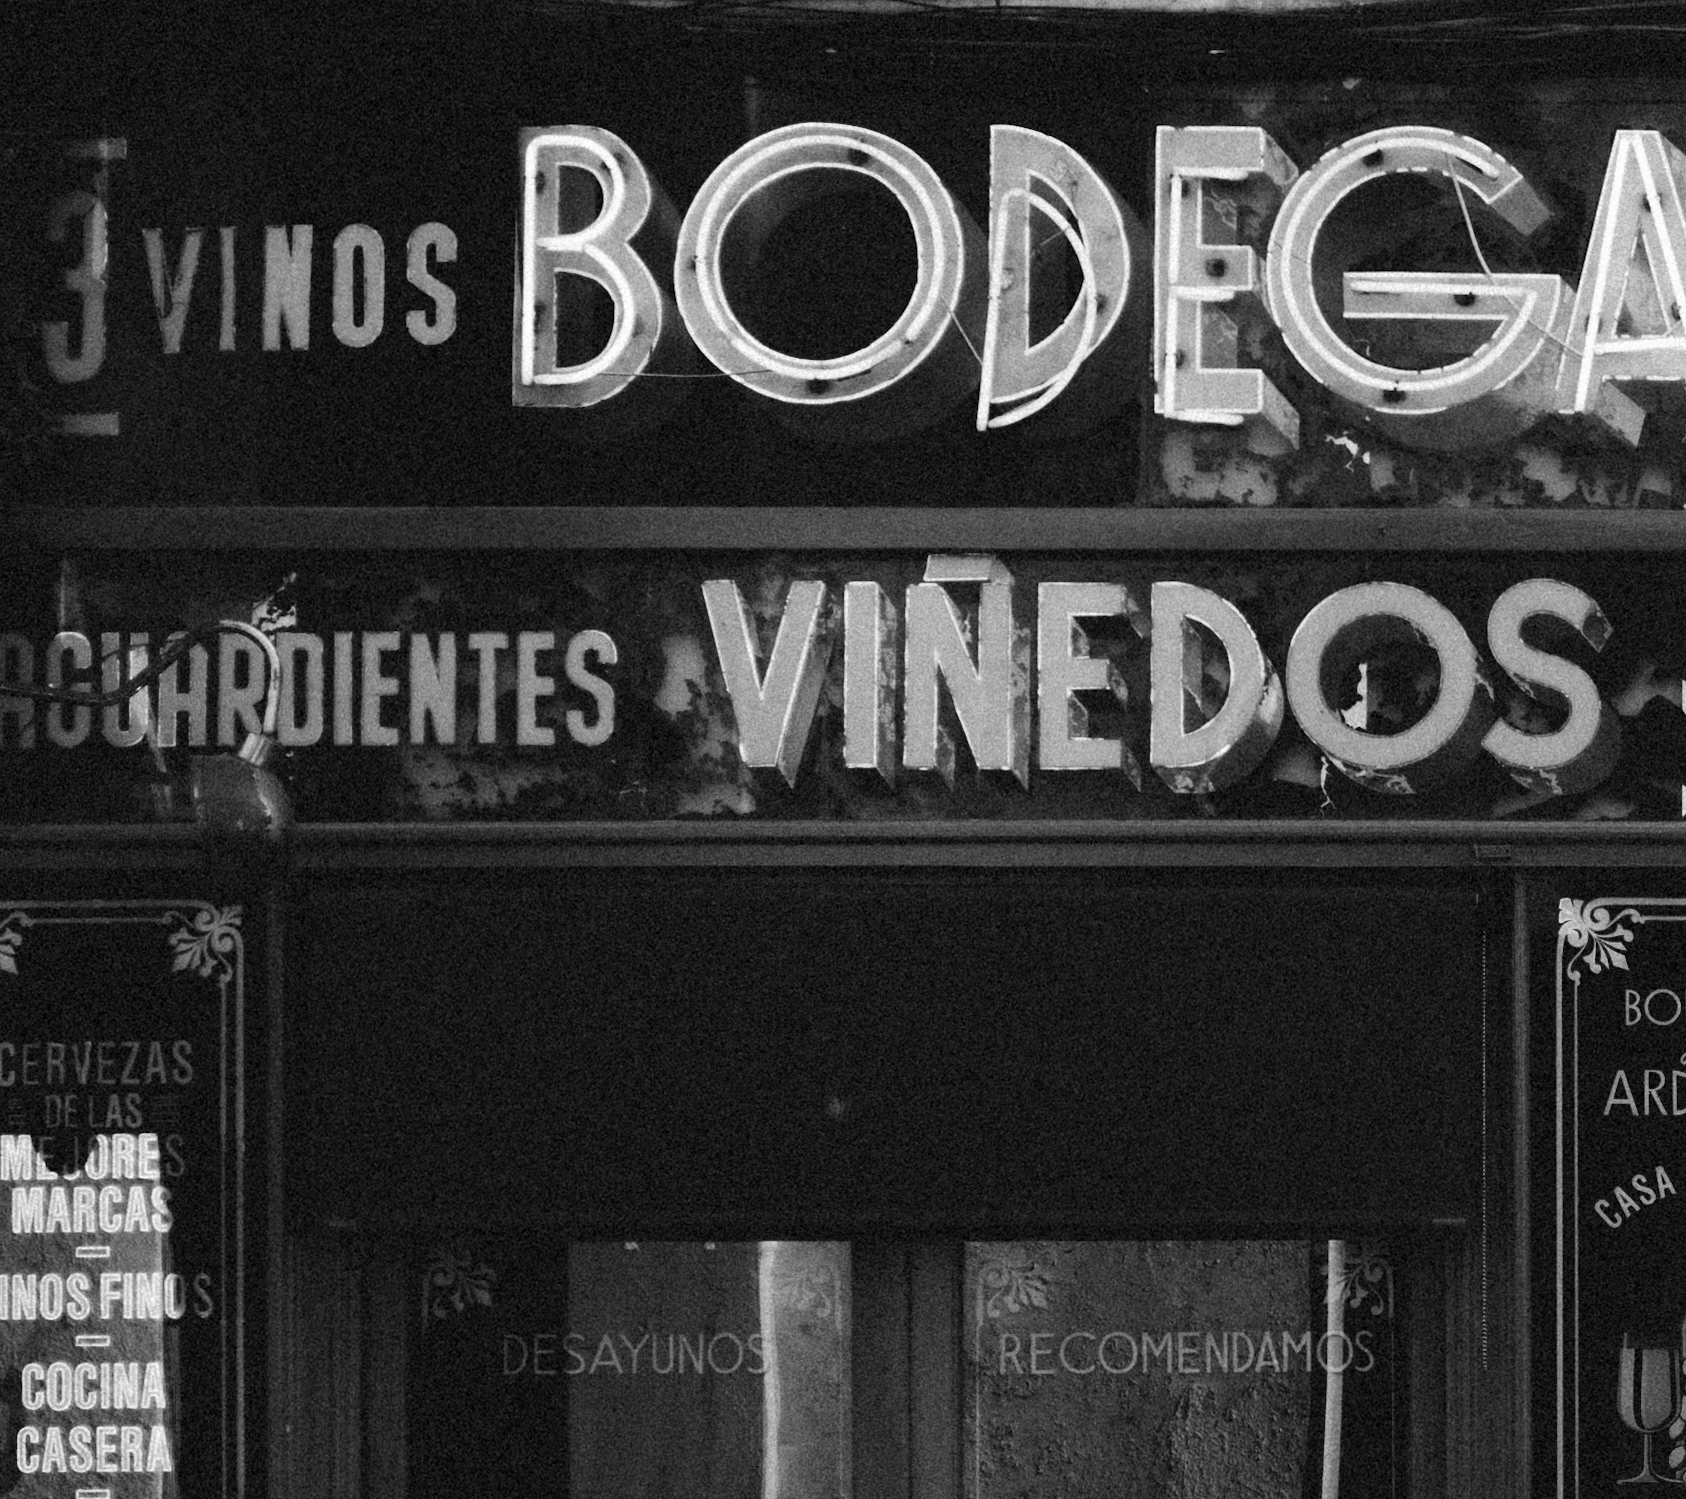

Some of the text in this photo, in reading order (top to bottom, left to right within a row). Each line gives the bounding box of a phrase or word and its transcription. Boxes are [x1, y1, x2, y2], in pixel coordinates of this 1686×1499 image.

[141, 221, 459, 354] VINOS
[701, 556, 1613, 786] VIÑEDOS
[0, 1040, 195, 1088] CERVEZAS
[44, 1093, 143, 1129] DE LAS
[10, 1185, 174, 1235] MARCAS
[1593, 1164, 1677, 1229] CASA
[99, 1271, 214, 1322] FINOS
[503, 1332, 768, 1375] DESAYUNOS
[999, 1330, 1376, 1375] RECOMENDAMOS
[20, 1360, 168, 1412] COCINA
[15, 1423, 175, 1475] CASERA
